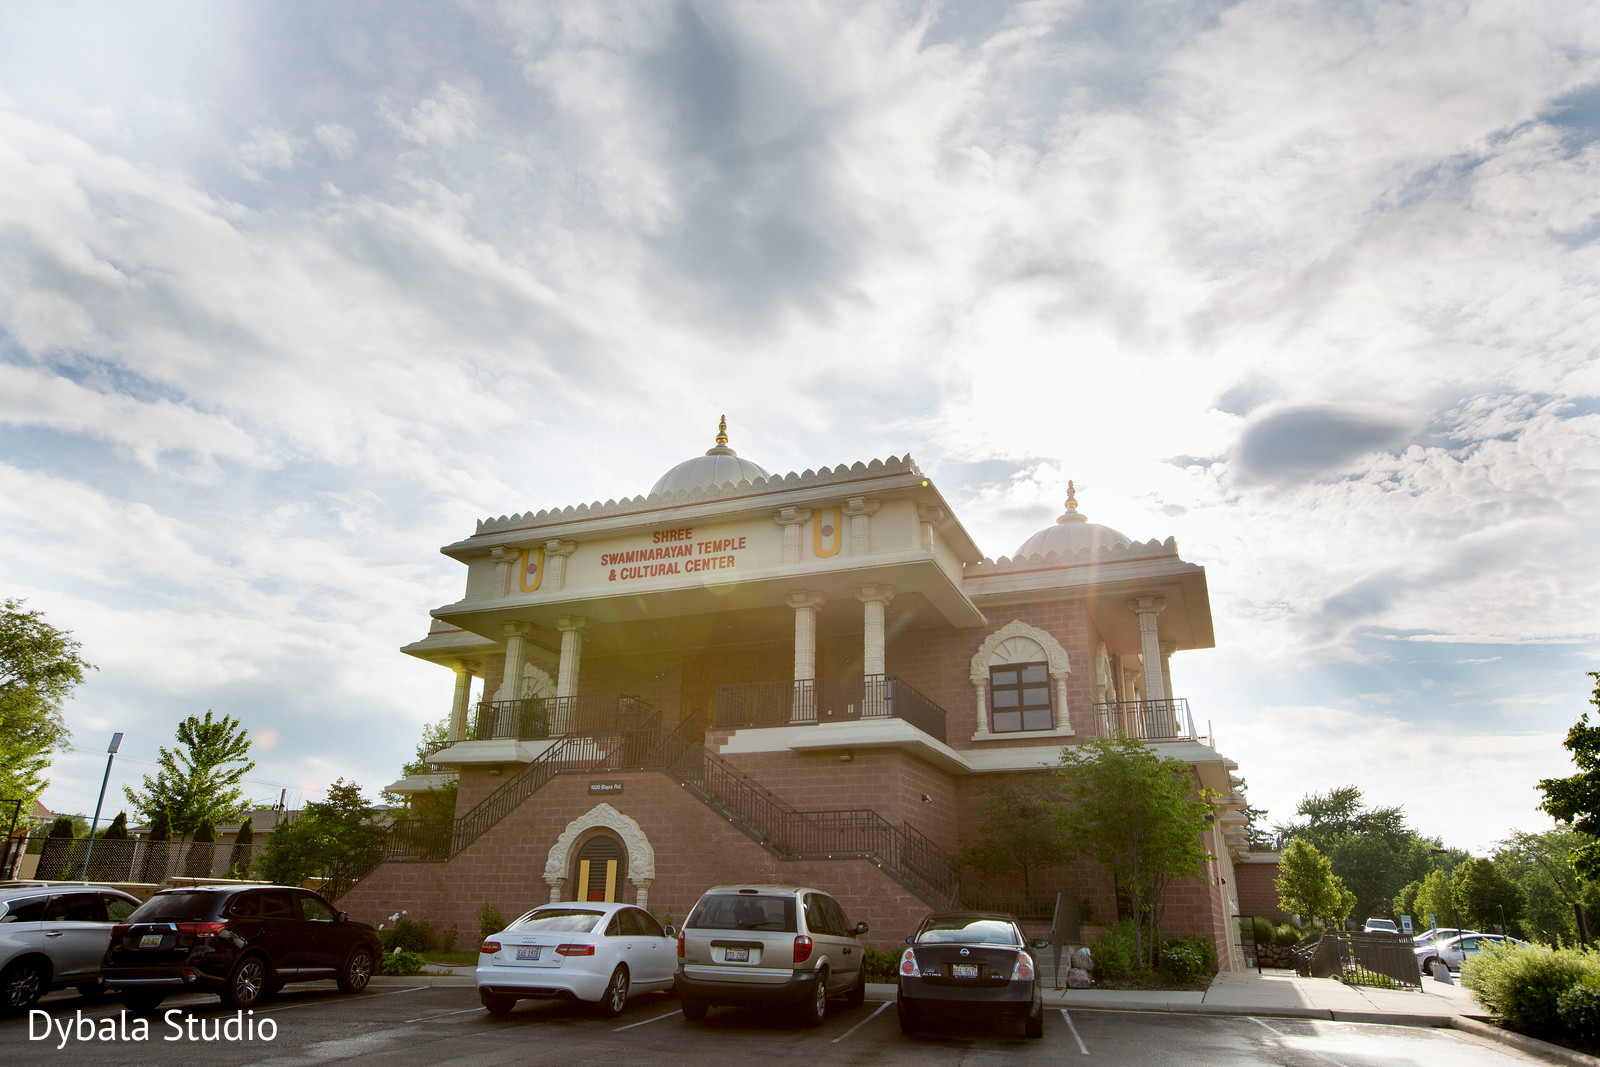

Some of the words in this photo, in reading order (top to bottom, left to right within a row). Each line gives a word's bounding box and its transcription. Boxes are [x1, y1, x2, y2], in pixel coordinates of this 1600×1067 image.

[652, 527, 693, 544] SHREE
[600, 544, 693, 566] SWAMINARAYAN
[697, 537, 746, 555] TEMPLE
[608, 569, 617, 581] &
[620, 562, 681, 580] CULTURAL
[685, 555, 735, 573] CENTER
